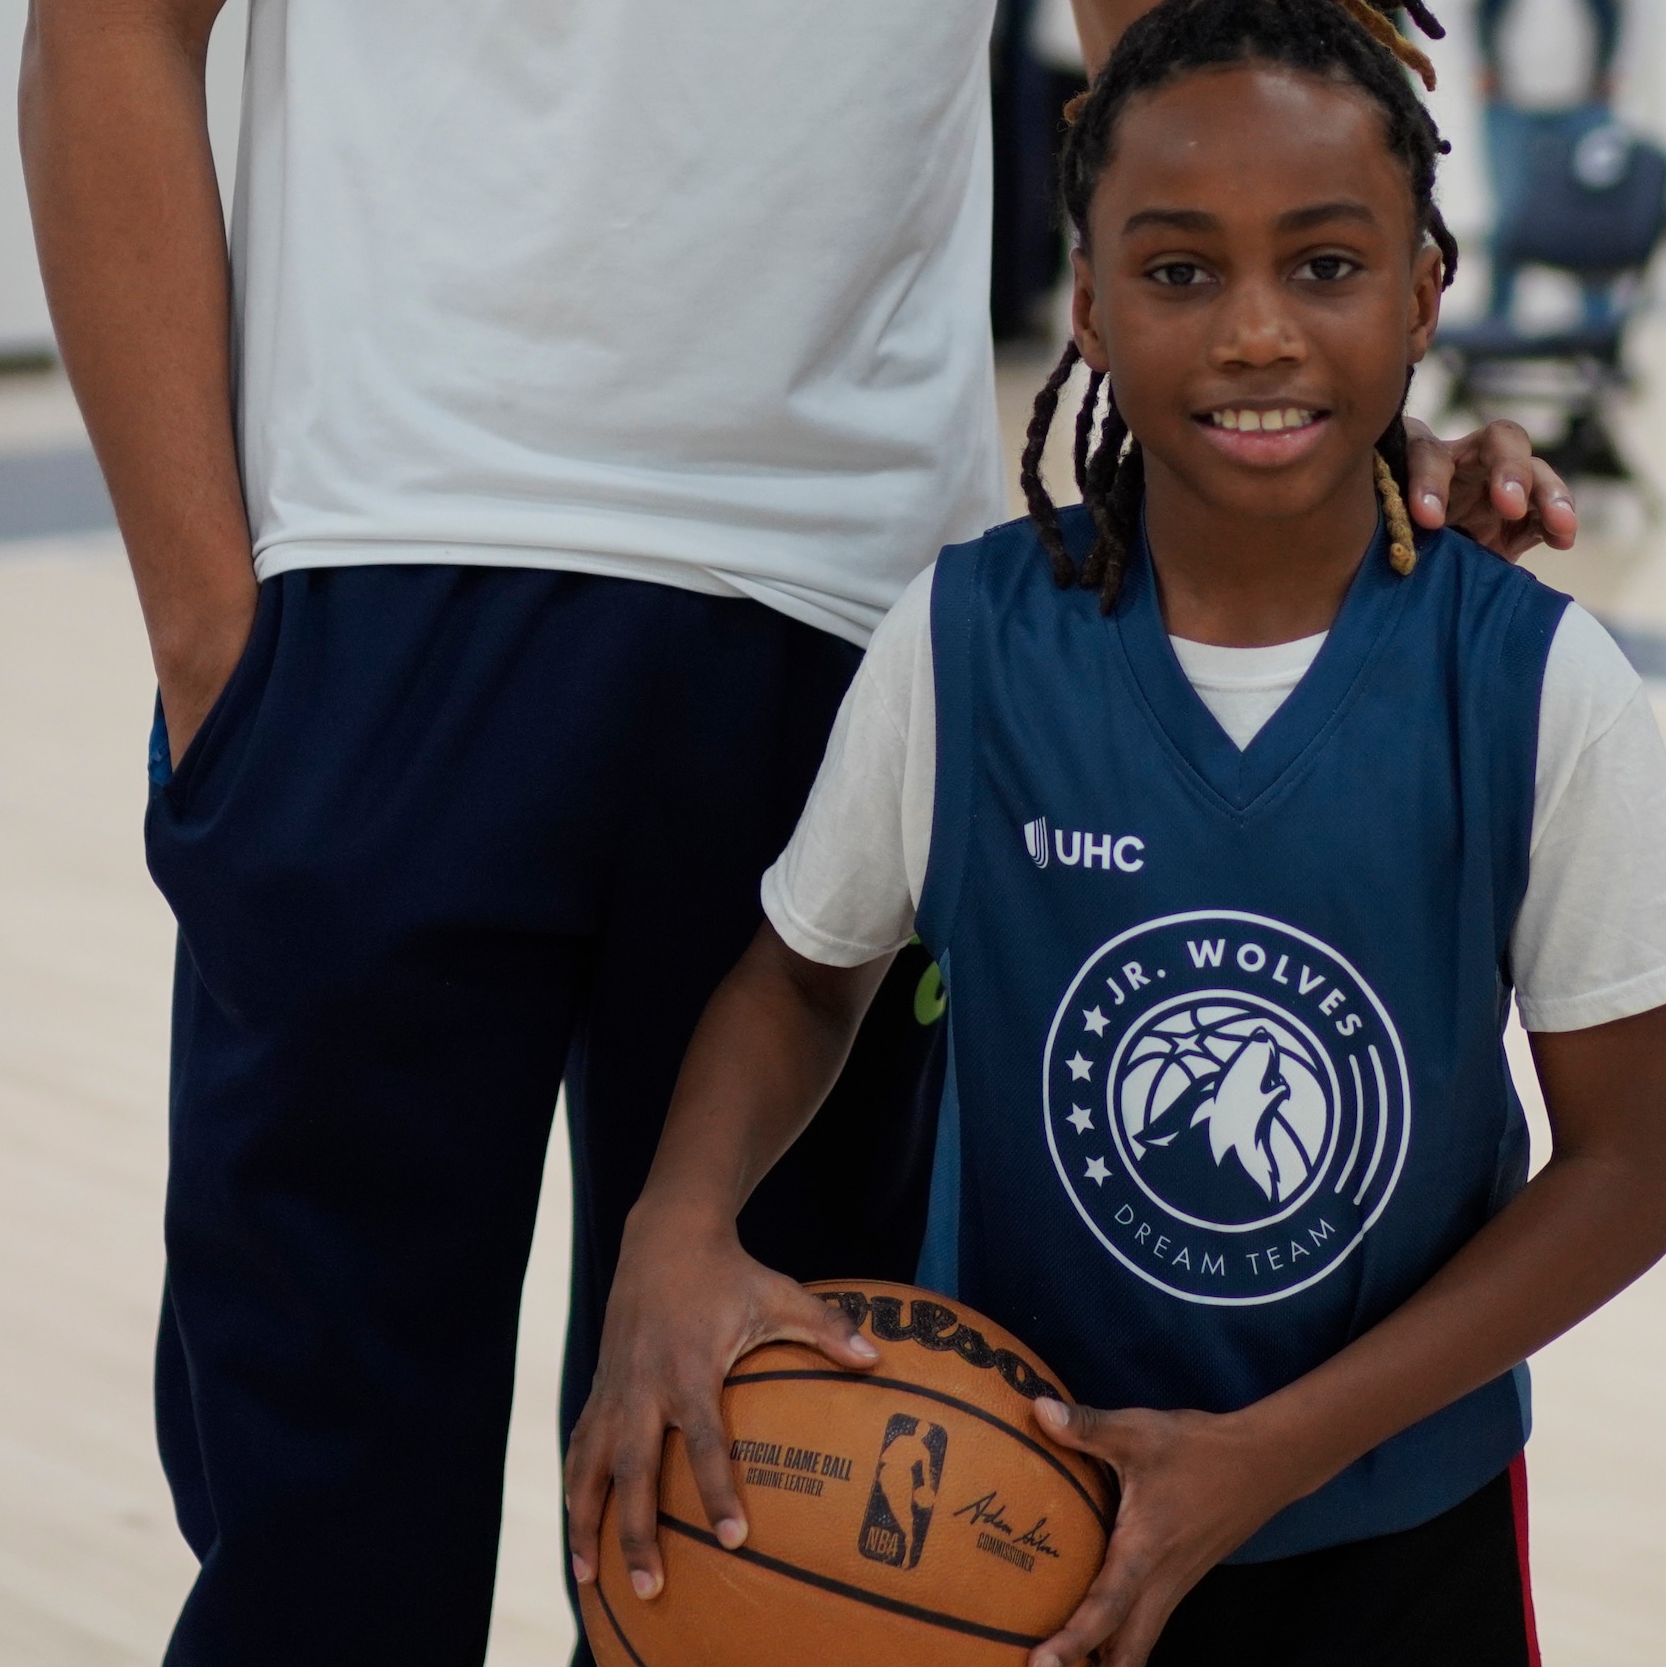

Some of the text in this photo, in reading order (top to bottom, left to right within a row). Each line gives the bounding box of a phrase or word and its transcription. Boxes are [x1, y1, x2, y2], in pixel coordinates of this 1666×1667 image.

[1054, 828, 1145, 873] UHC
[1106, 938, 1362, 1037] JR. WOLVES
[1114, 1203, 1336, 1276] DREAM TEAM
[730, 1439, 853, 1482] OFFICIAL GAME BALL
[746, 1467, 824, 1497] GENUINE LEATHER
[864, 1525, 899, 1559] NBA
[976, 1532, 1035, 1573] COMMISSIONER
